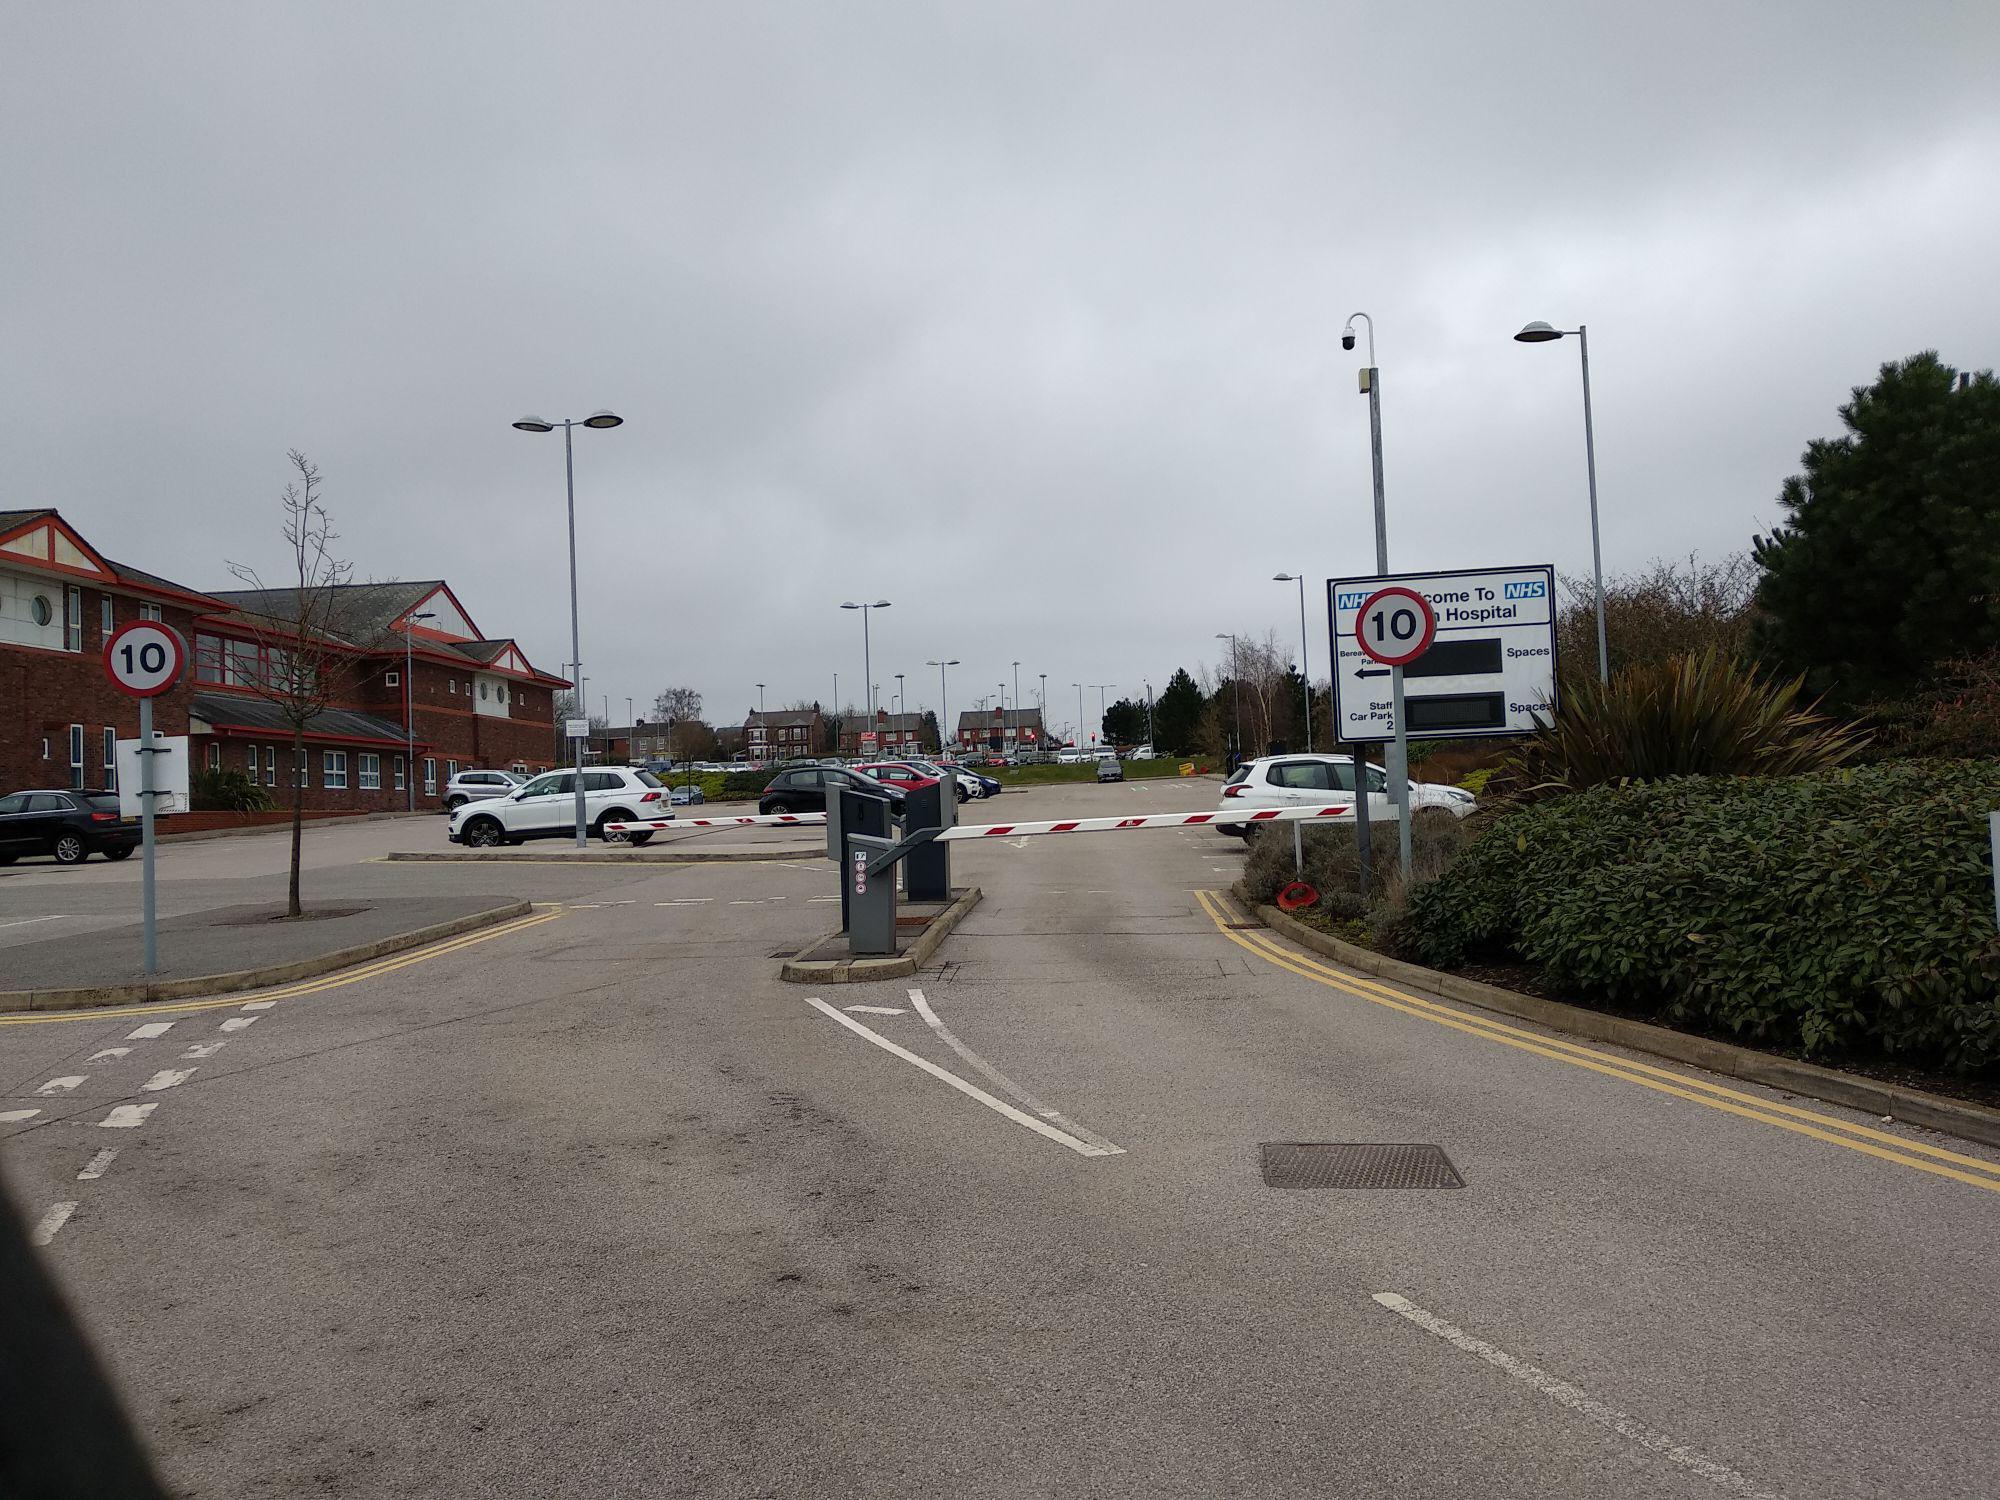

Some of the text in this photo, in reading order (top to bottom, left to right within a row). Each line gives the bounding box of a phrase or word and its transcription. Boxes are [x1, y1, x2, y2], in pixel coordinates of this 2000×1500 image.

[1418, 587, 1495, 603] come To
[1505, 582, 1544, 598] NHS
[1340, 593, 1374, 608] NH
[1446, 604, 1517, 622] Hospital
[1371, 609, 1416, 641] 10
[121, 643, 166, 674] 10
[1507, 647, 1550, 658] Spaces
[1369, 701, 1393, 710] Staff
[1350, 711, 1393, 721] Car Park
[1386, 721, 1394, 730] 2
